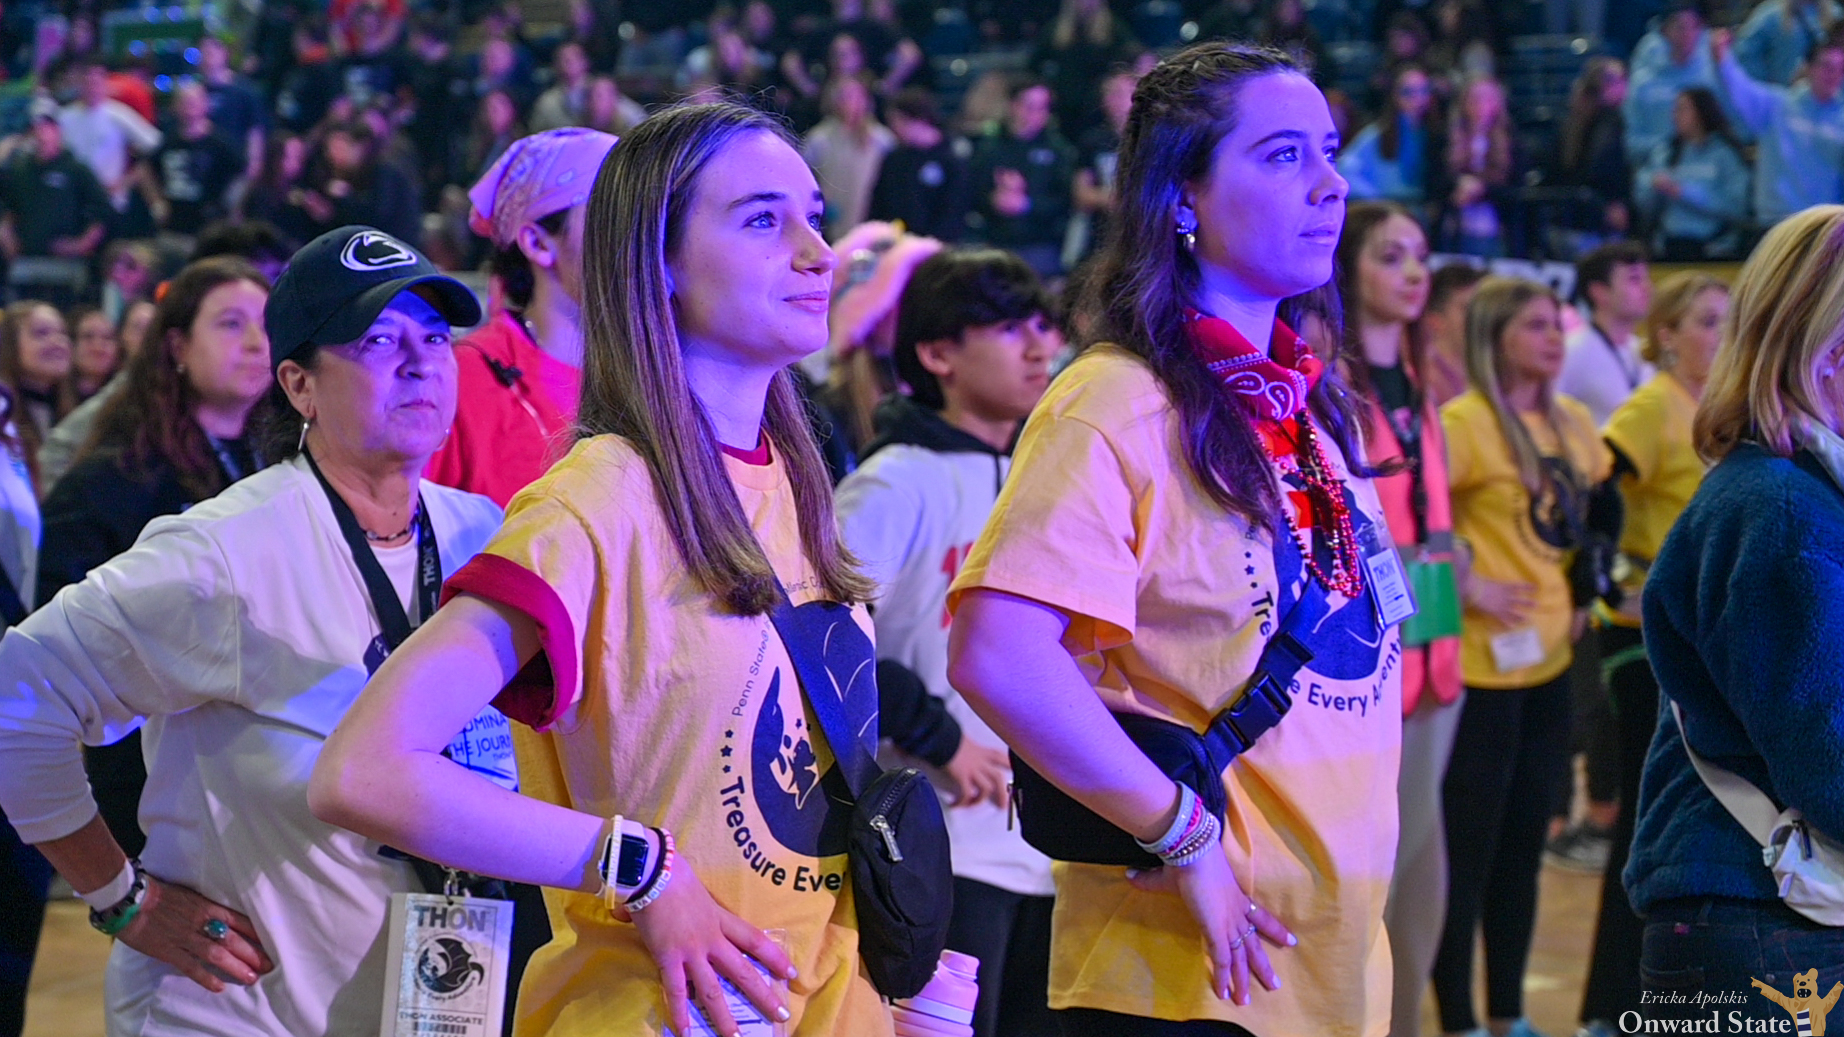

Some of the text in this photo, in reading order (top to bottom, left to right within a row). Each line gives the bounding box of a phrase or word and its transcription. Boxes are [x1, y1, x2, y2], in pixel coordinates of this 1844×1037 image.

[423, 546, 436, 587] THON
[732, 679, 755, 717] Penn
[1307, 682, 1368, 717] Every
[720, 775, 842, 892] Treasure Eve
[414, 904, 487, 932] THON
[429, 1013, 483, 1025] ASSOCIATE
